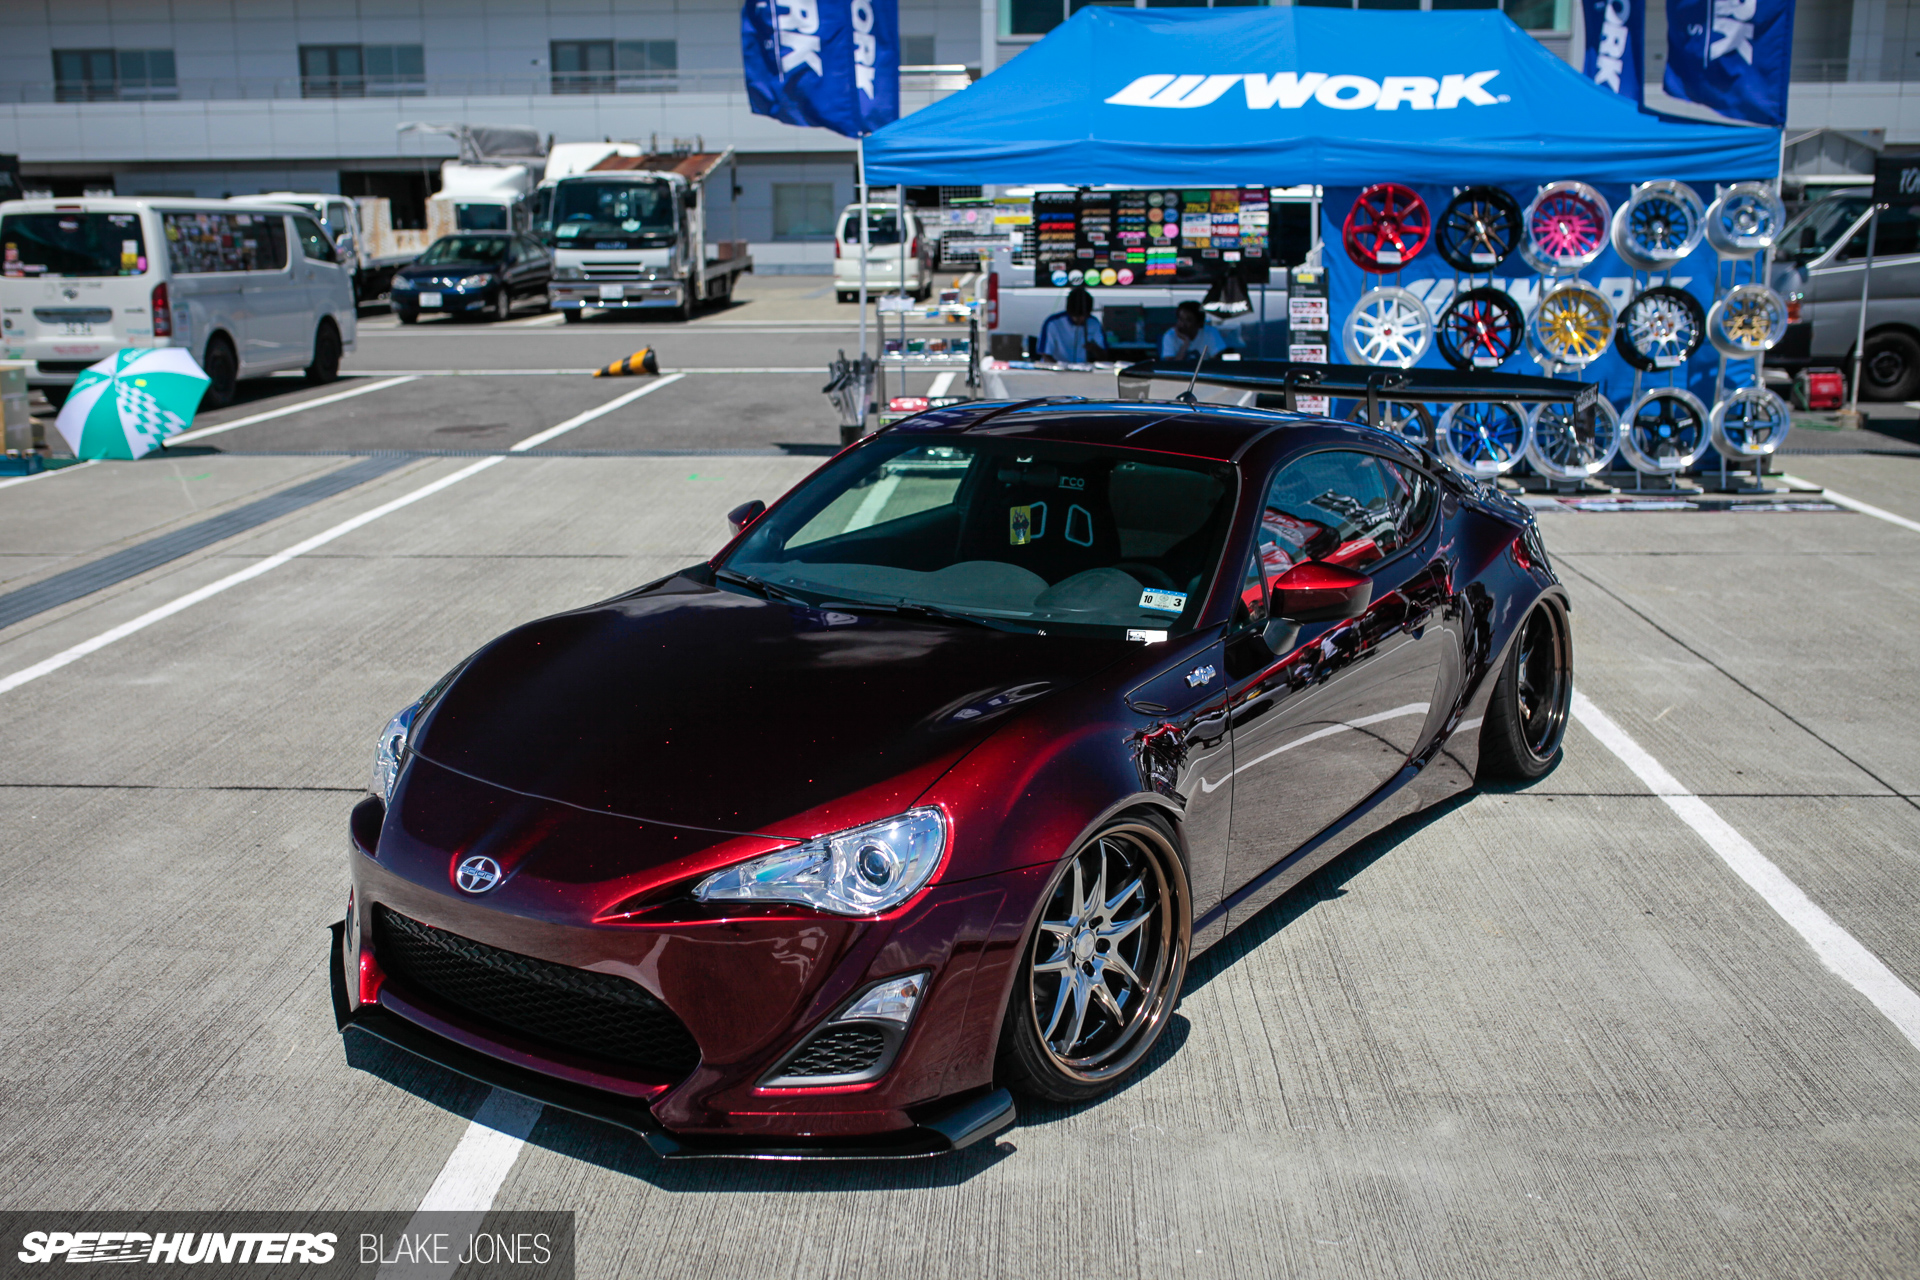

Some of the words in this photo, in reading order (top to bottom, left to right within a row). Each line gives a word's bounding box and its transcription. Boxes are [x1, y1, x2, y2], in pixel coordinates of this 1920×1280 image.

[851, 0, 876, 100] ORK
[1242, 69, 1501, 110] WORK
[1173, 598, 1182, 607] 3
